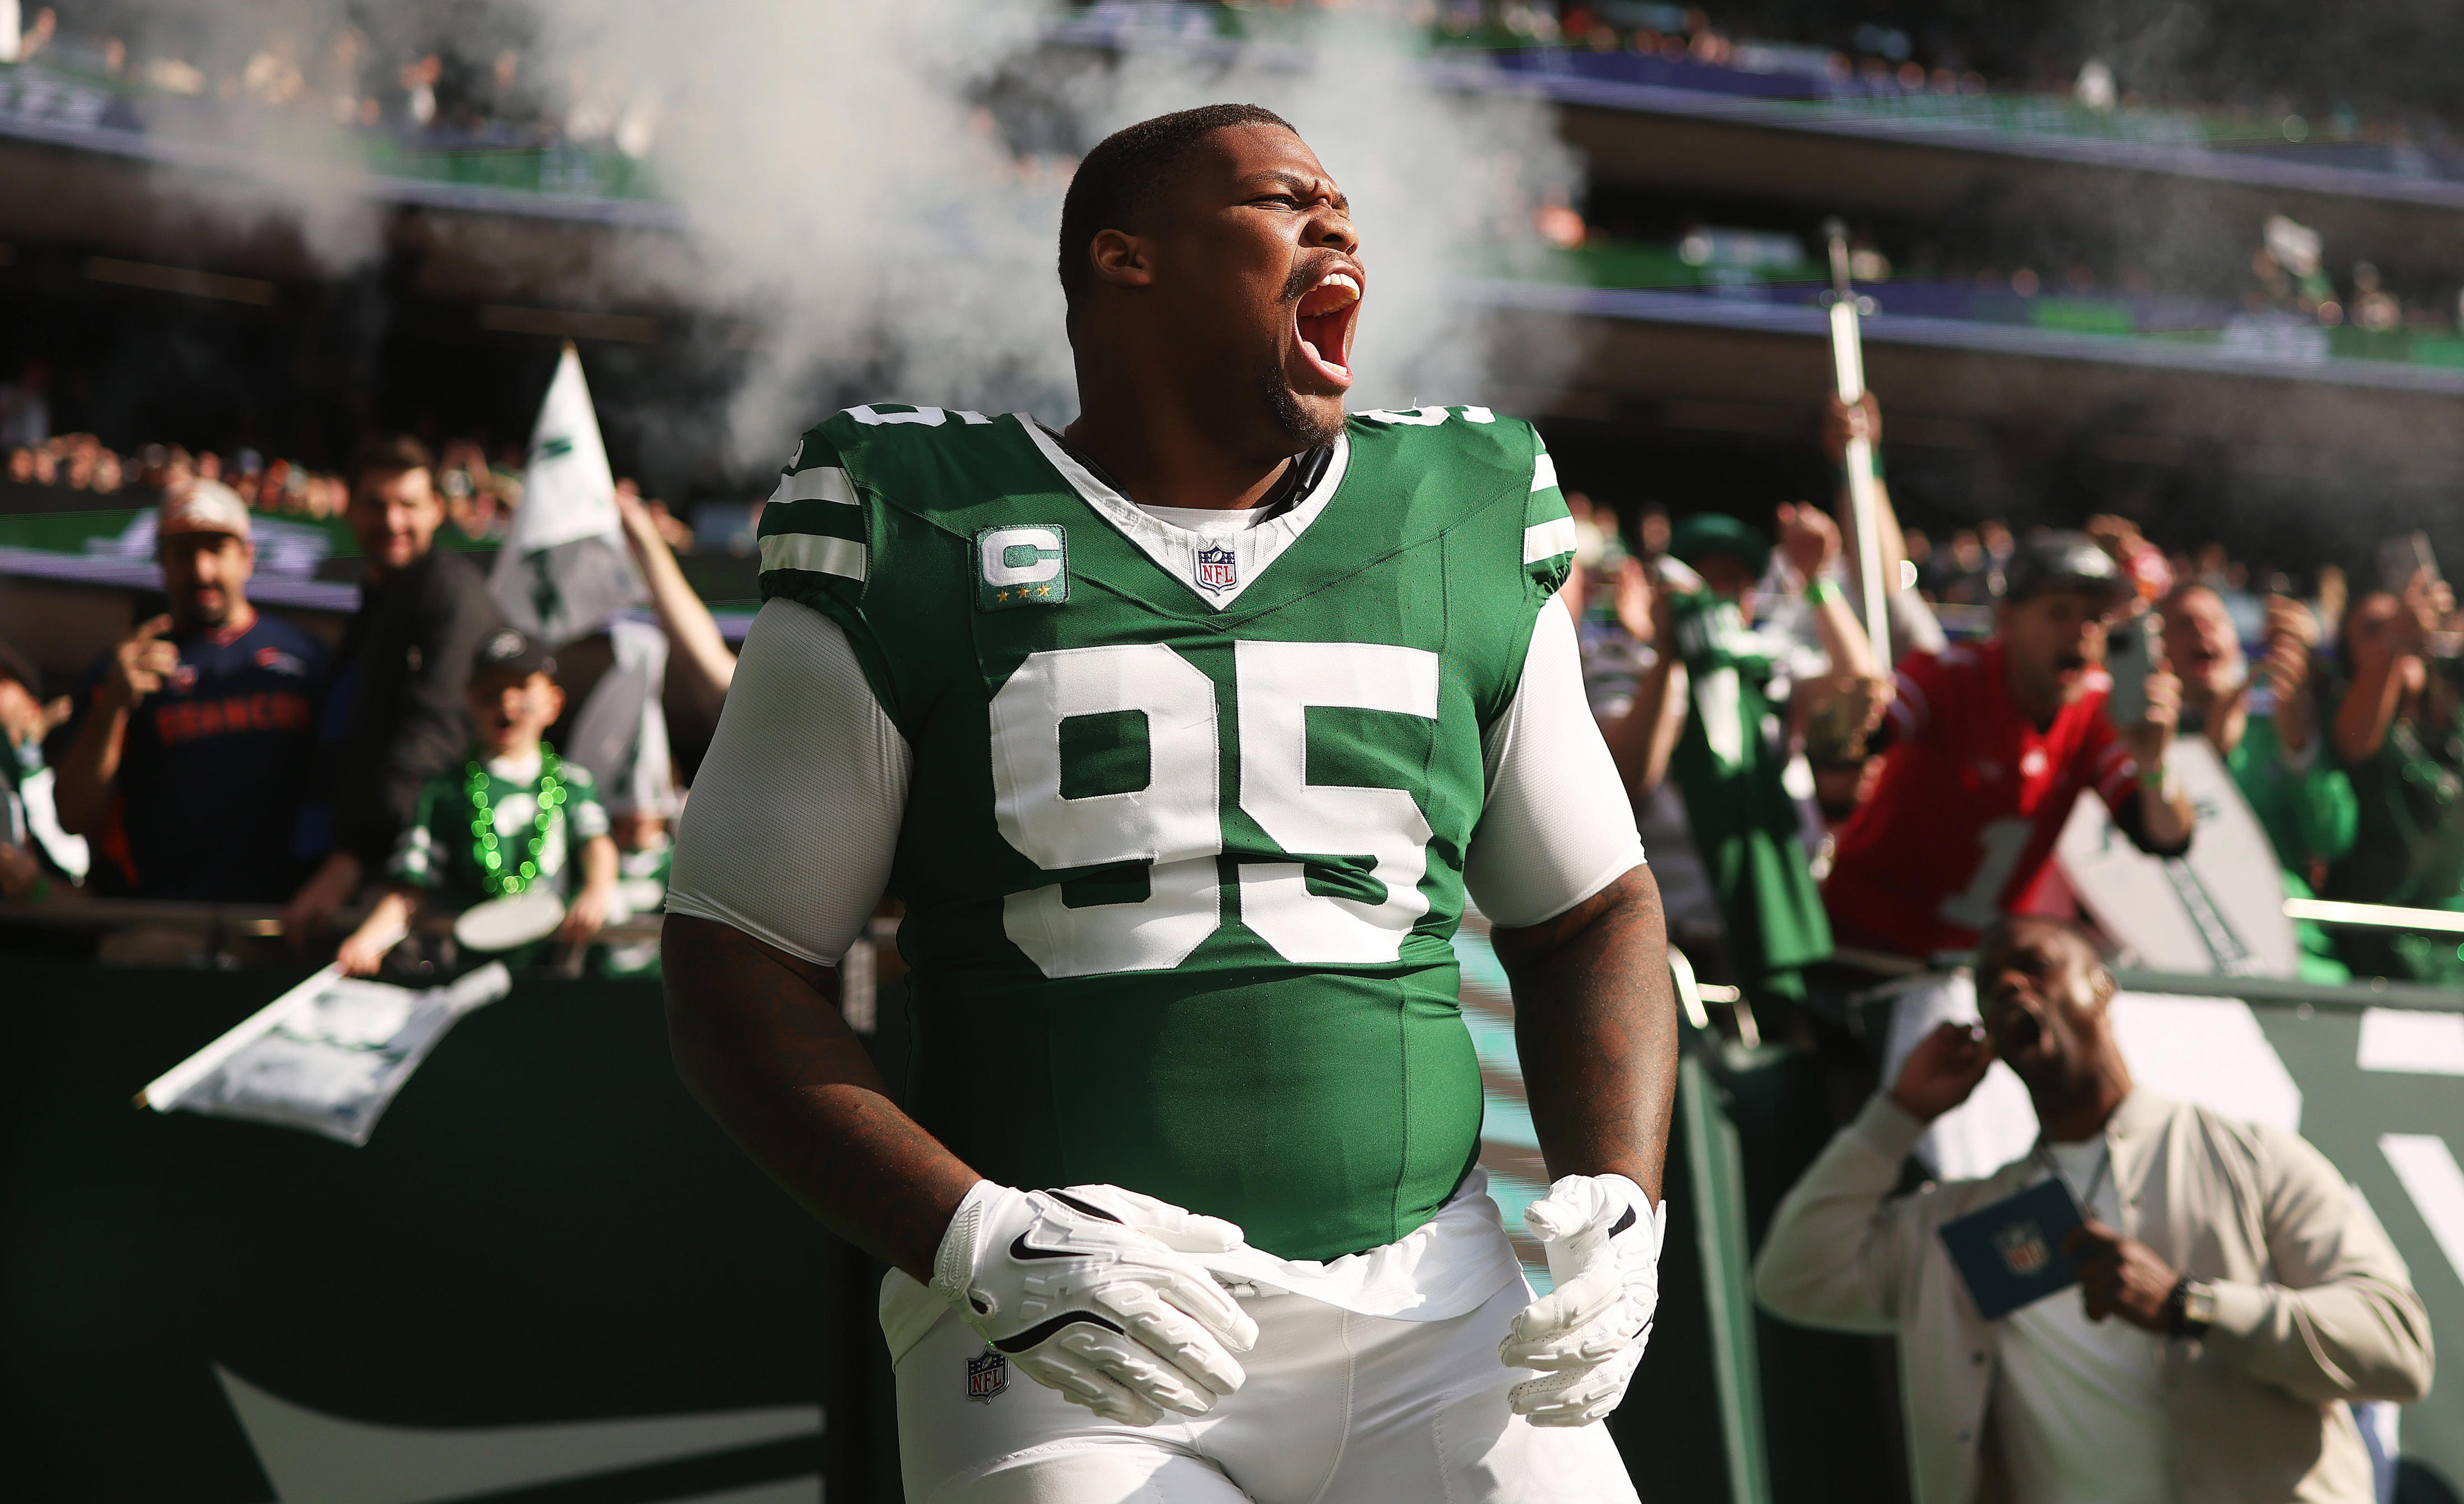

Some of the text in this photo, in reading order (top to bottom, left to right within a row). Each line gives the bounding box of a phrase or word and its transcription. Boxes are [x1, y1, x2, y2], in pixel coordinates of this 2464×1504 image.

[982, 529, 1061, 587] C
[1203, 564, 1234, 585] NFL
[989, 640, 1439, 979] 95
[971, 1368, 1003, 1394] NFL
